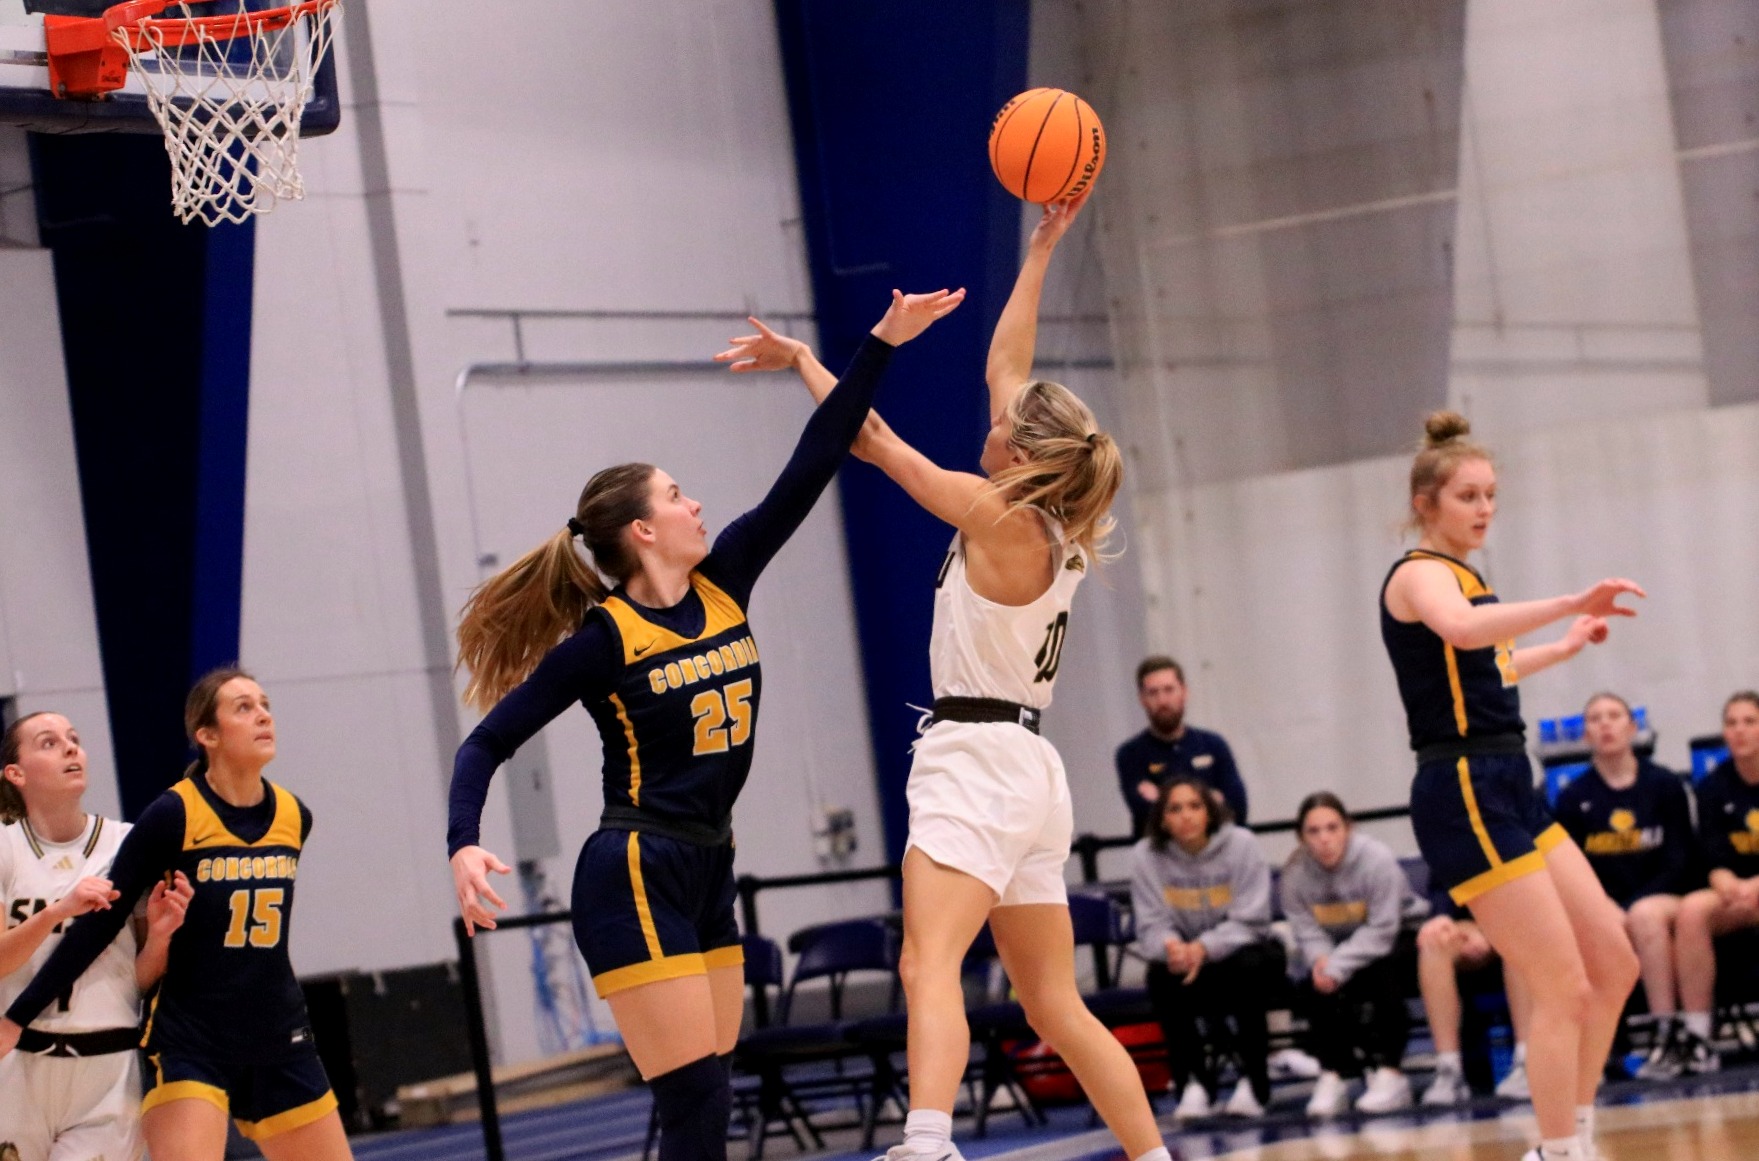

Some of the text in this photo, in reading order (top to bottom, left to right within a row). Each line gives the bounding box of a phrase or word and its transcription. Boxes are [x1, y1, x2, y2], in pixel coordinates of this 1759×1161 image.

[1066, 128, 1099, 197] Wilson
[1033, 611, 1068, 683] 10
[690, 678, 752, 756] 25
[223, 888, 284, 948] 15
